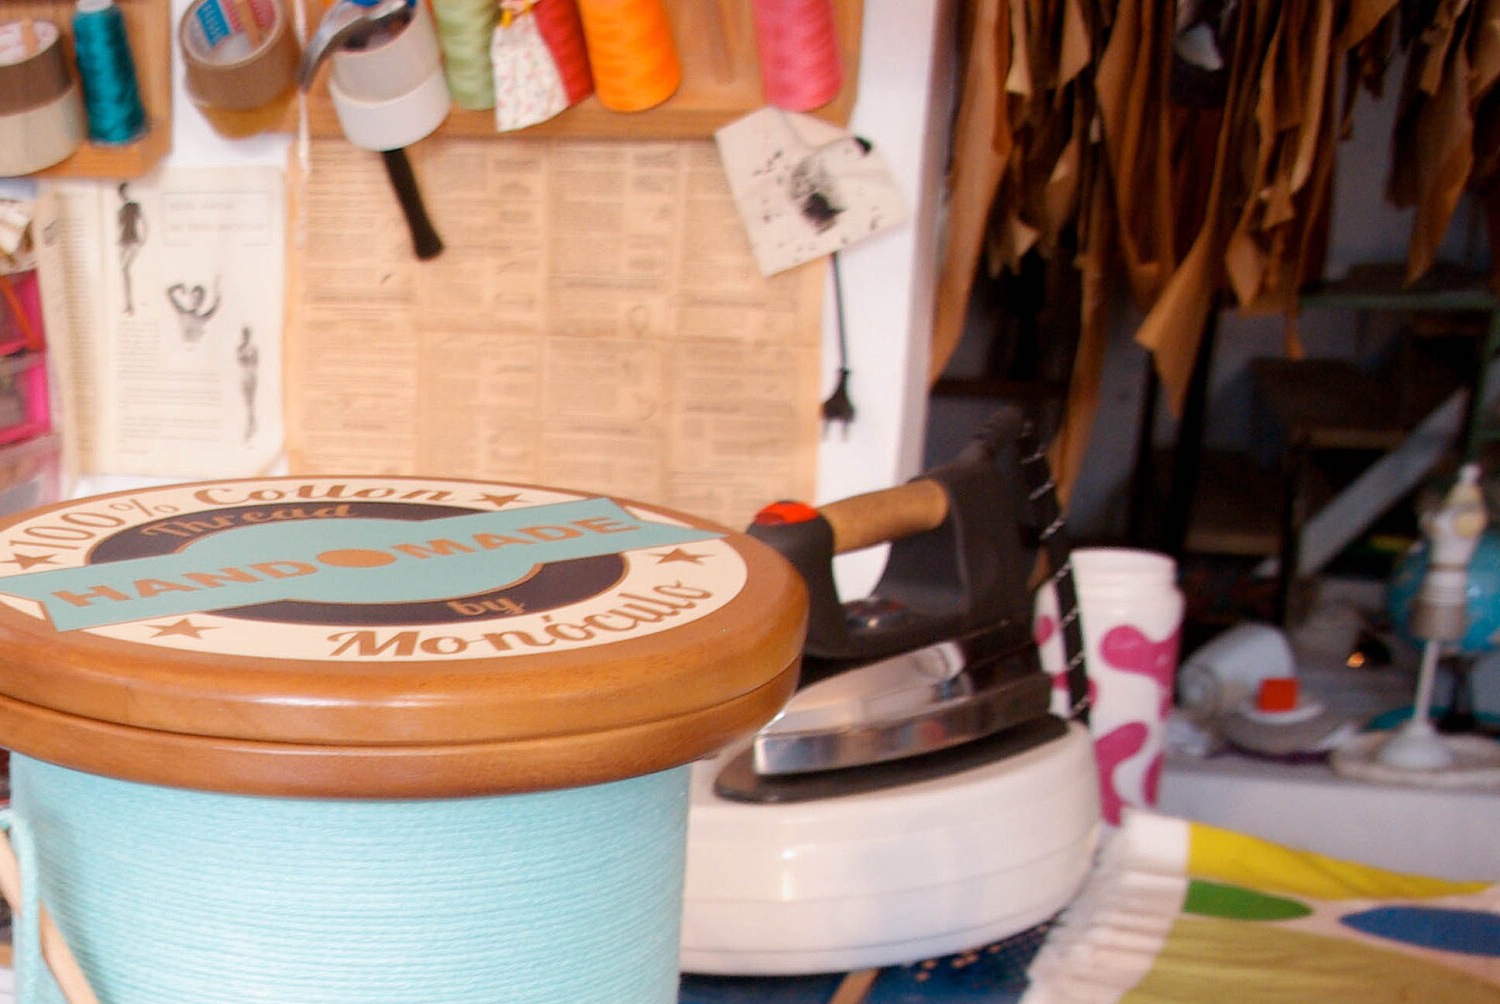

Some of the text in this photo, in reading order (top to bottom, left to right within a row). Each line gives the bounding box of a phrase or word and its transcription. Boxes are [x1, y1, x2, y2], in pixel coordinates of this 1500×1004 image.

[9, 484, 453, 550] 100% Cotton
[141, 503, 358, 539] Thread
[52, 516, 640, 608] HAND MADE
[328, 580, 713, 657] Monóculo
[447, 598, 526, 616] by
